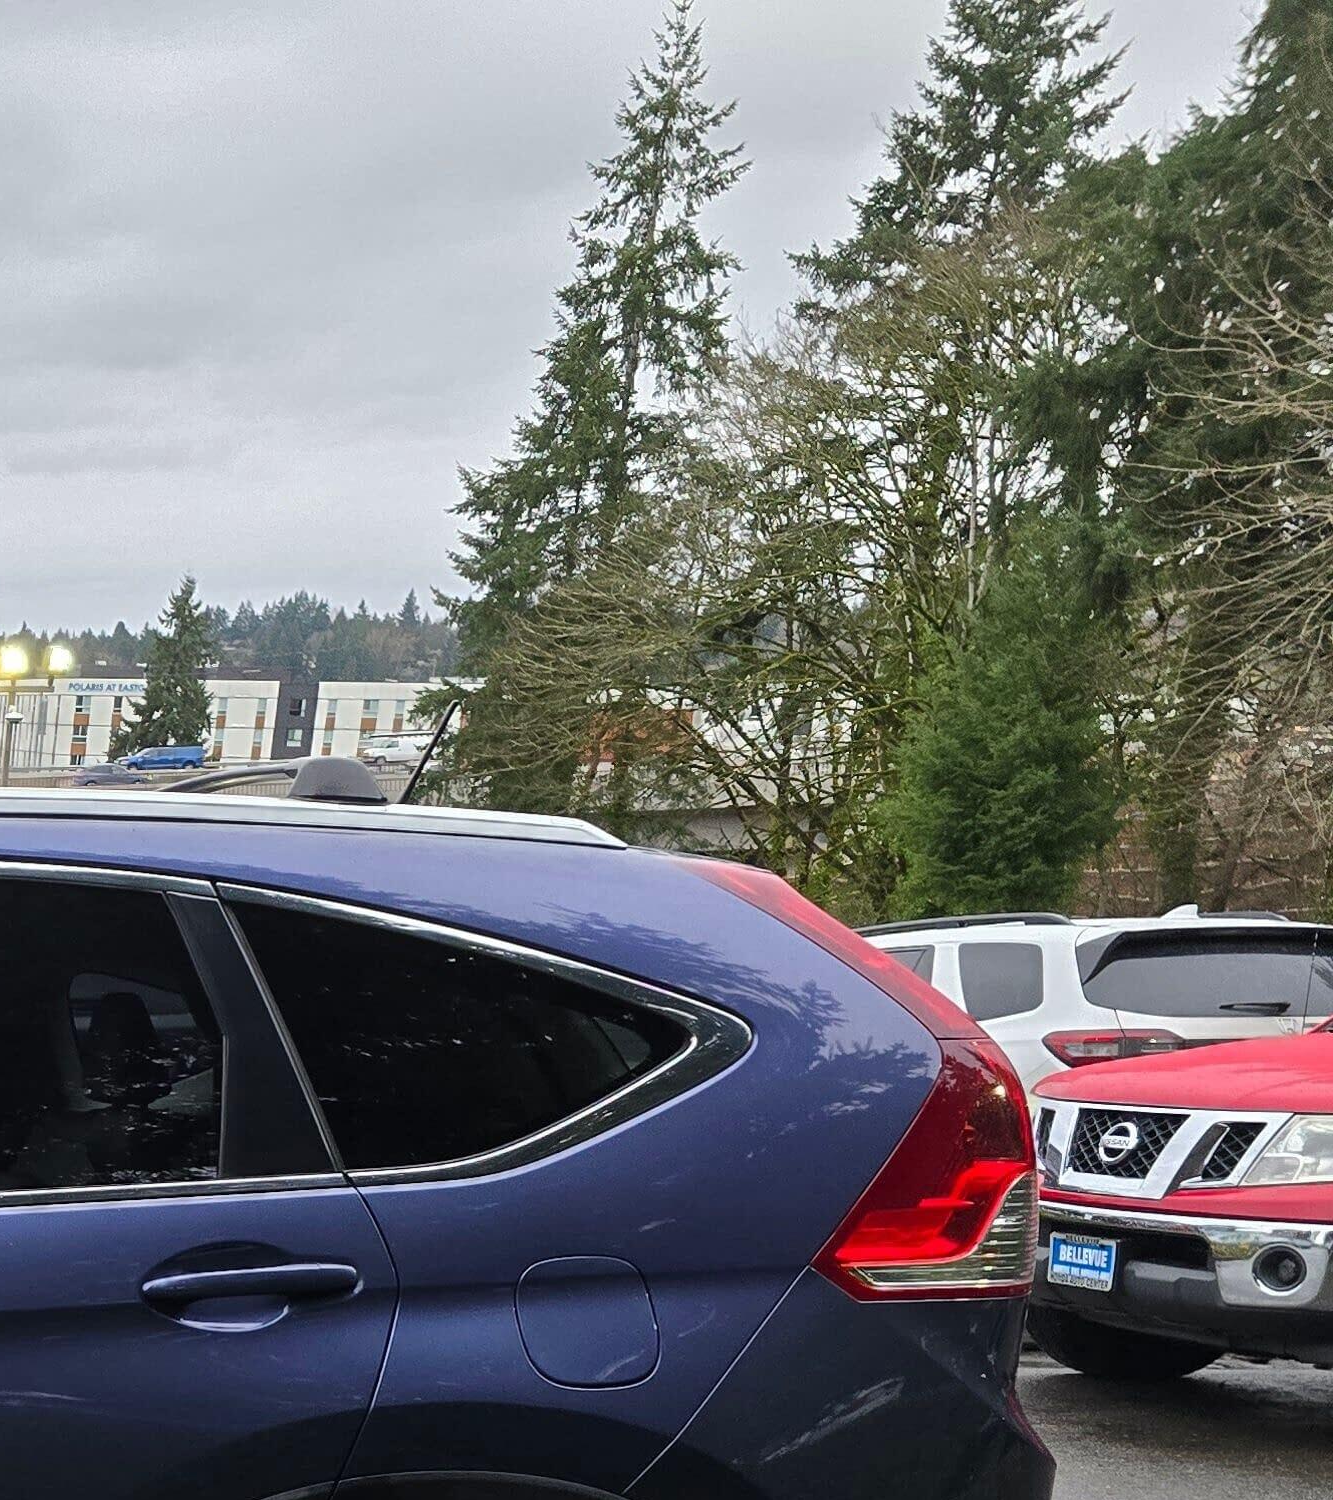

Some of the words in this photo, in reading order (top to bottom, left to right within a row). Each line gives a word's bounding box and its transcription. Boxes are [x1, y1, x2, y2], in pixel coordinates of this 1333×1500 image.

[69, 682, 103, 692] POLARIS
[106, 683, 116, 692] AT
[1059, 1244, 1109, 1269] BELLEVUE
